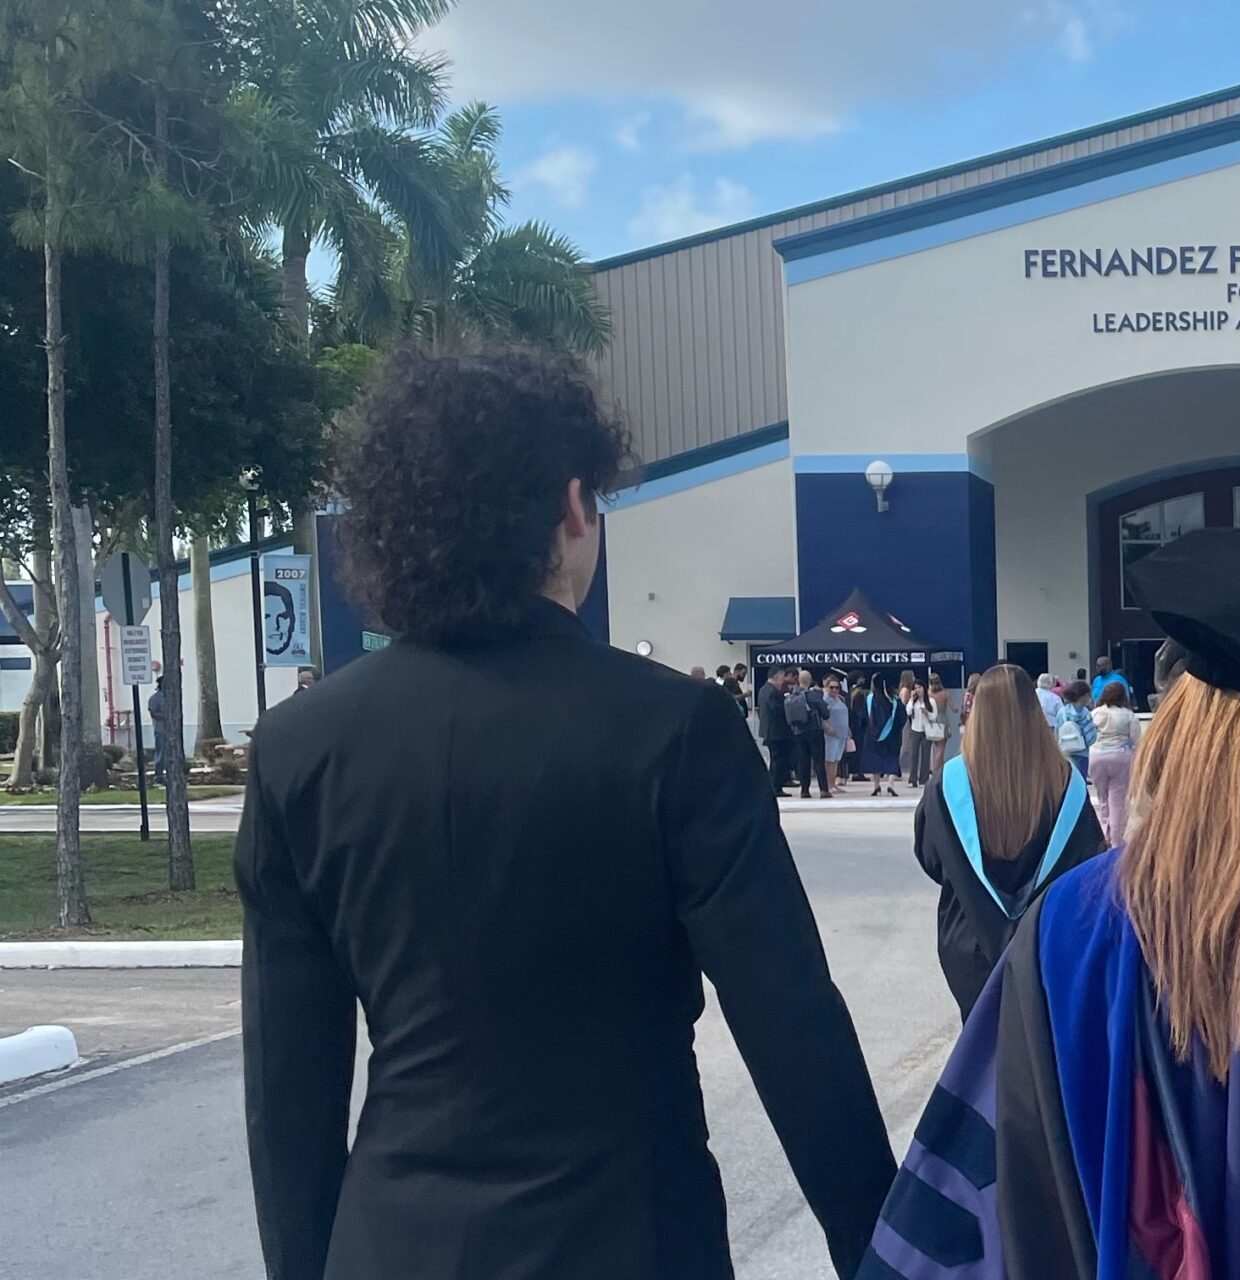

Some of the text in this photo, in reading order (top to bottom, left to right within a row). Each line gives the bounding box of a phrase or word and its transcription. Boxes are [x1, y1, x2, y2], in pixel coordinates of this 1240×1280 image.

[1024, 245, 1218, 278] FERNANDEZ
[1093, 310, 1229, 333] LEADERSHIP
[276, 569, 306, 579] 2007
[756, 652, 869, 665] COMMENCEMENT
[871, 652, 909, 664] GIFTS
